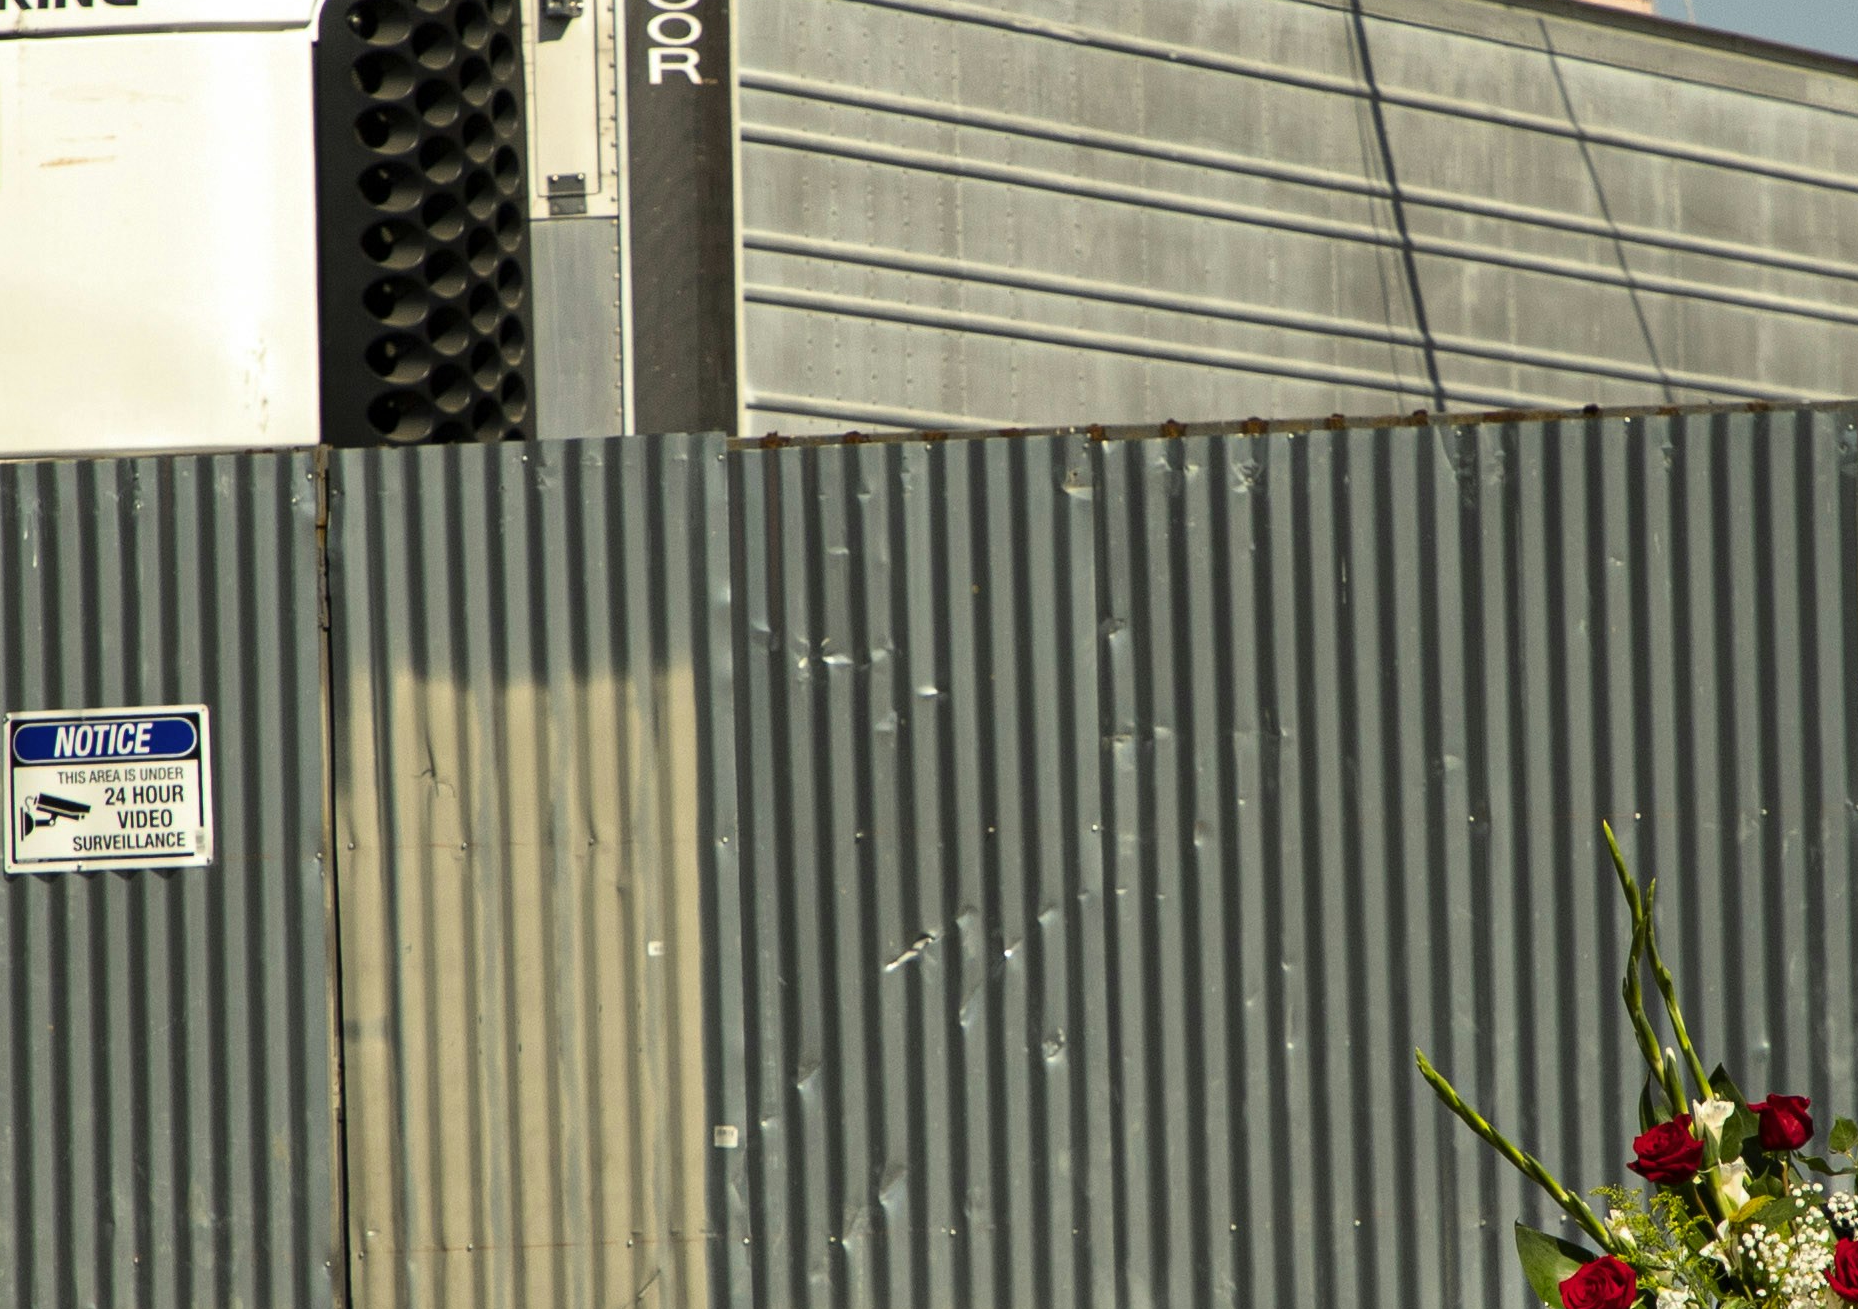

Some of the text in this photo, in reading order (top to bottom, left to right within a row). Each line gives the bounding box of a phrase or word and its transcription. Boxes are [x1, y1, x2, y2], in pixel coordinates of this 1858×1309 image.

[54, 723, 153, 758] NOTICE
[57, 767, 184, 784] THIS AREA IS UNDER
[105, 785, 184, 806] 24 HOUR
[117, 809, 173, 829] VIDEO
[73, 832, 186, 852] SURVEILLANCE
